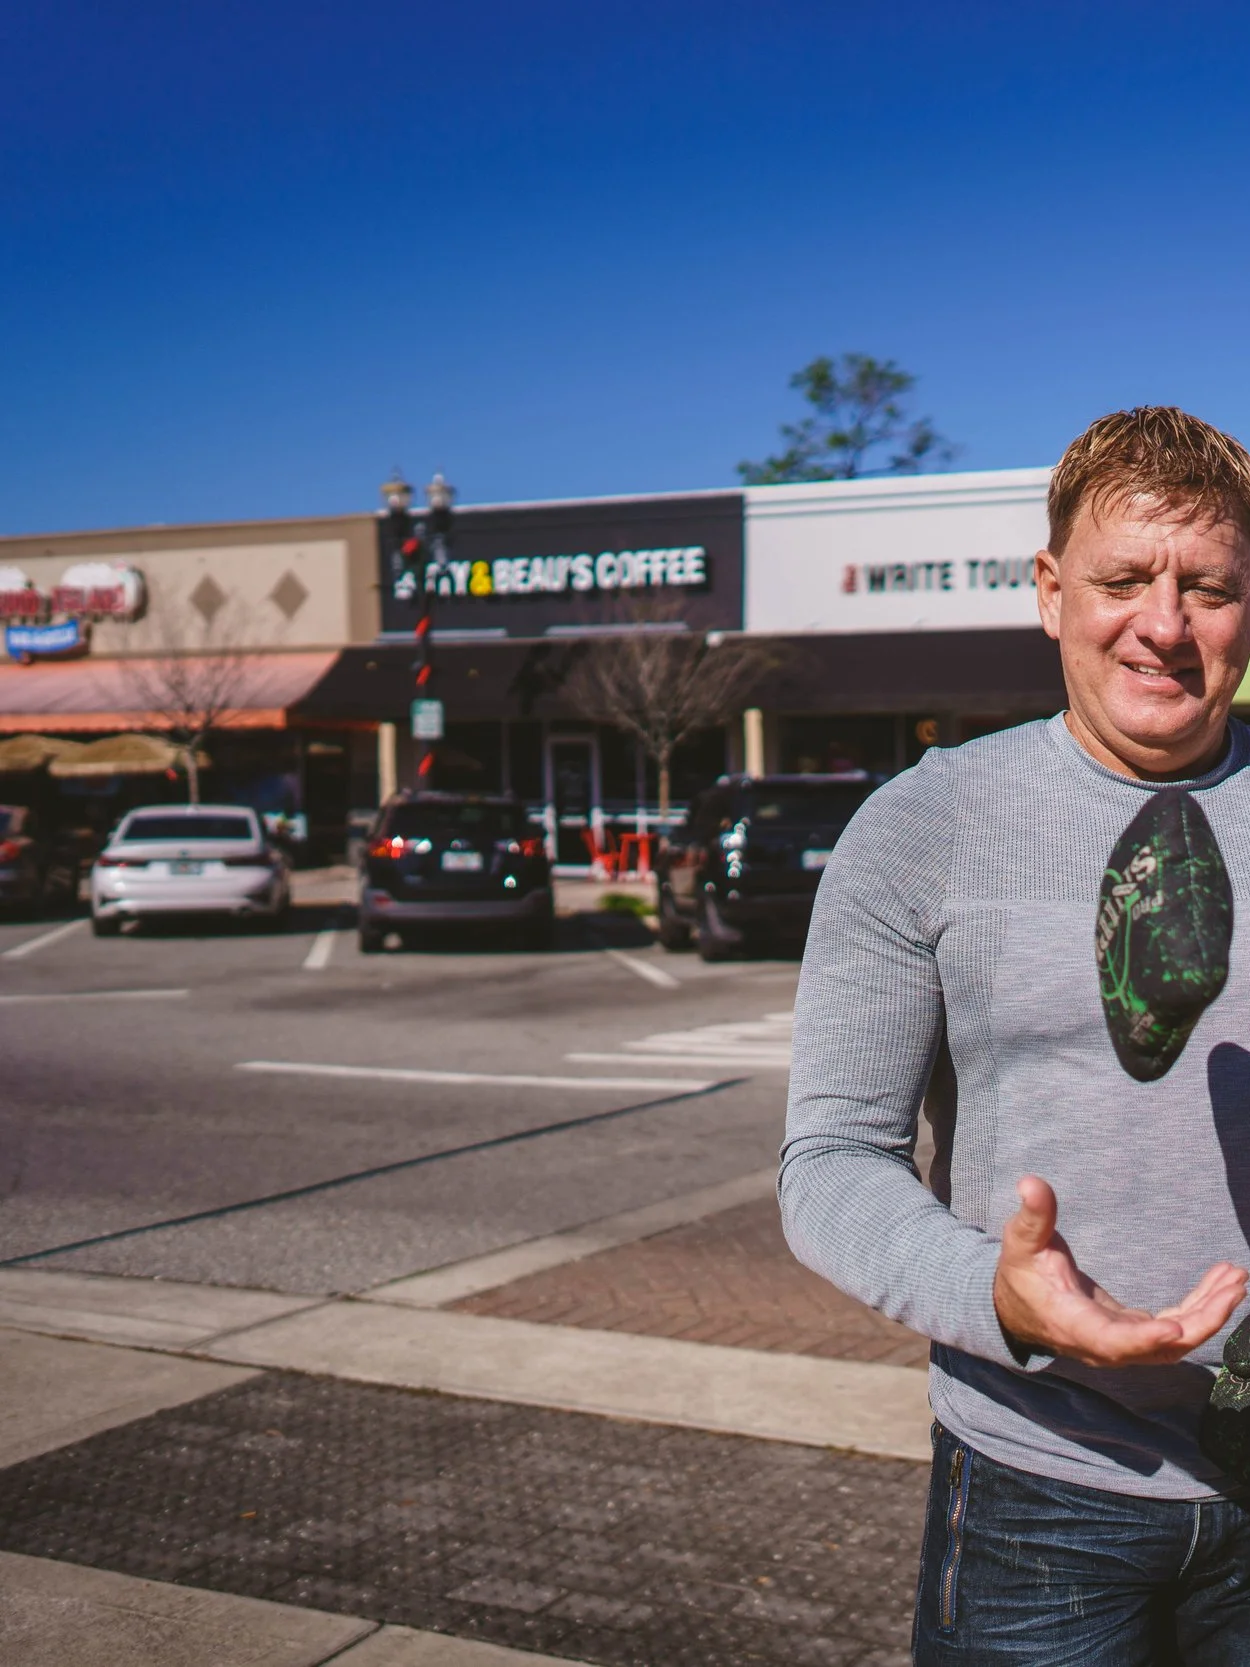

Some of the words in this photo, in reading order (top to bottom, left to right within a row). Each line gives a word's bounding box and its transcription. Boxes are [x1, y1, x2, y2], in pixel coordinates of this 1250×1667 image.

[595, 545, 706, 588] COFFEE
[864, 560, 954, 592] WRITE
[965, 556, 1037, 590] TOUC
